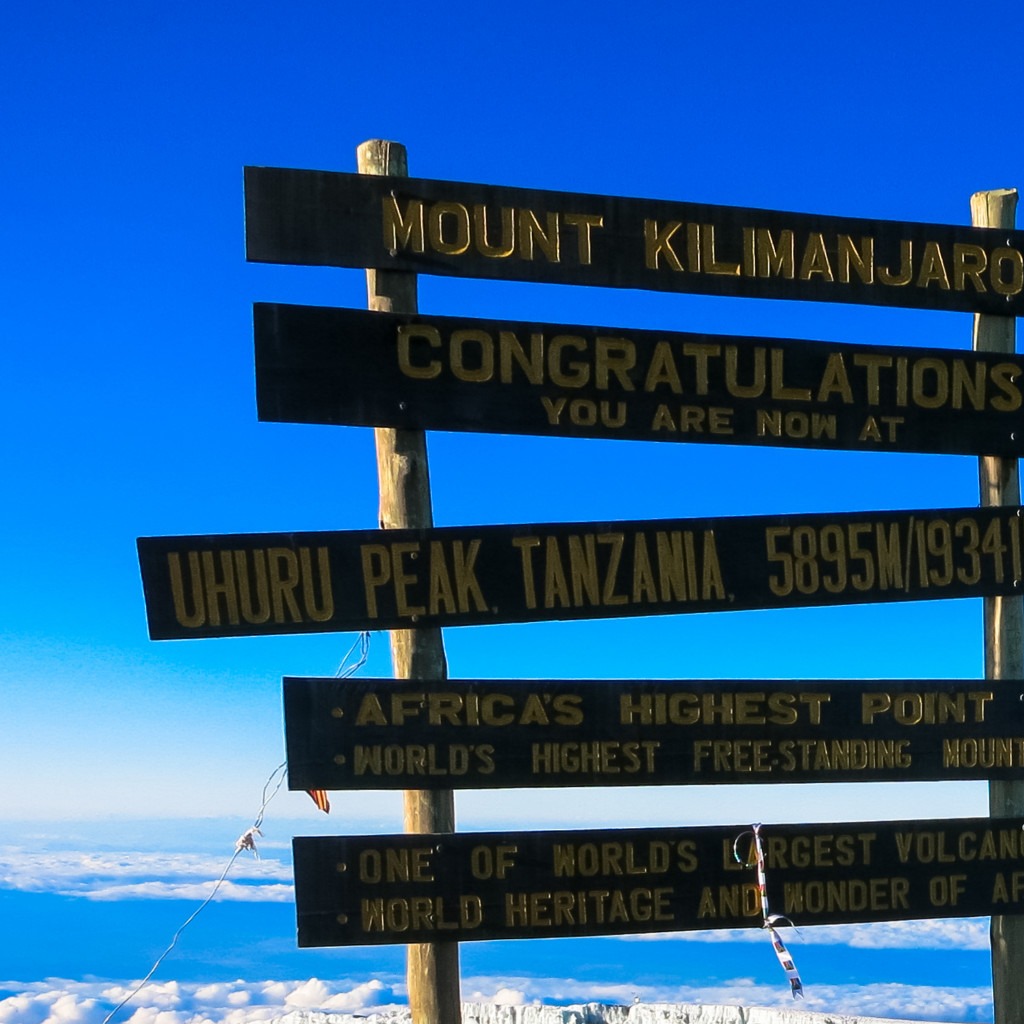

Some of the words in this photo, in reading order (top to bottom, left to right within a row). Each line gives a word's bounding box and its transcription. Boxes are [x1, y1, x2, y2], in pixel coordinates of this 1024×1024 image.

[382, 197, 604, 265] MOUNT
[643, 218, 1024, 295] KILIMANJARO
[398, 324, 1024, 411] CONGRATULATIONS
[541, 396, 627, 428] YOU
[652, 403, 734, 434] ARE
[756, 408, 837, 439] NOW
[859, 415, 905, 443] AT
[168, 546, 334, 629] UHURU
[354, 692, 584, 726] AFRICA'S
[619, 692, 831, 726] HIGHEST
[861, 692, 994, 726] POINT
[353, 743, 495, 775] WORLD'S
[532, 741, 660, 774] HIGHEST
[359, 847, 435, 884] ONE
[471, 845, 518, 880] OF
[552, 840, 698, 878] WORLD'S
[360, 894, 482, 932] WORLD
[505, 887, 675, 928] HERITAGE
[697, 882, 762, 919] AND
[784, 877, 910, 914] WONDER
[929, 874, 967, 907] OF
